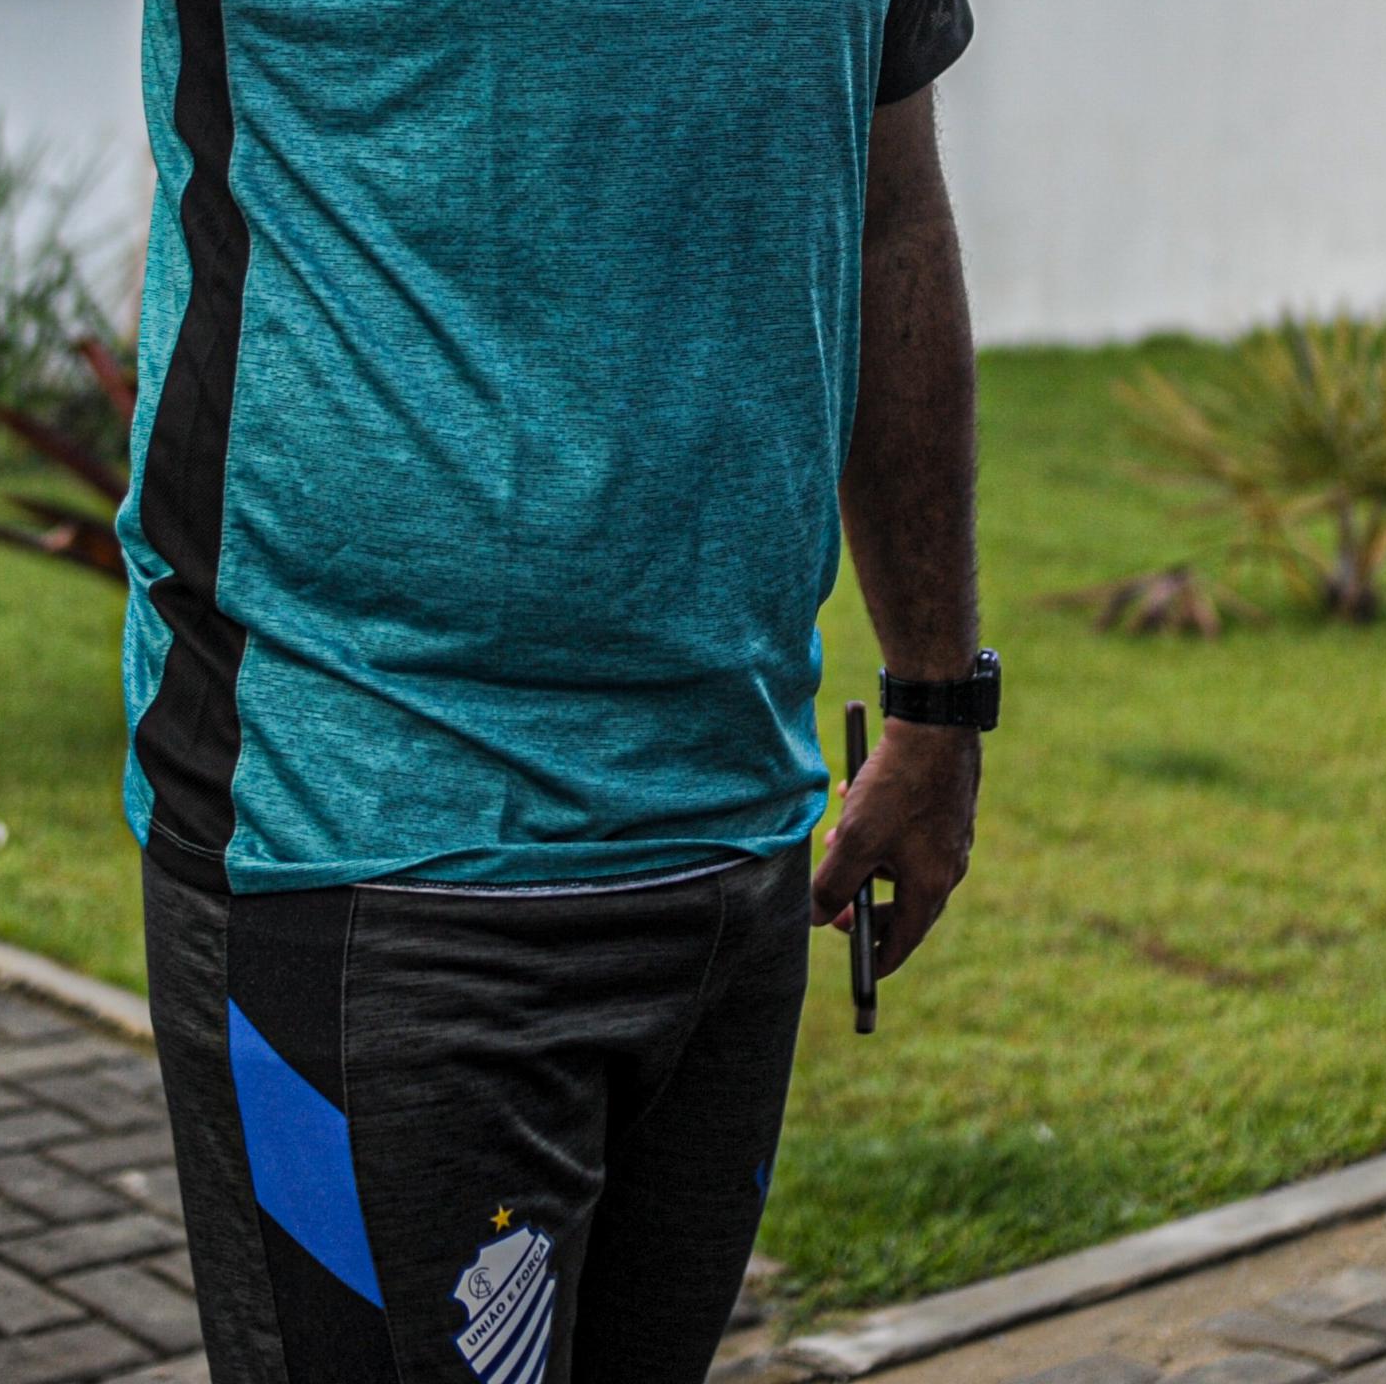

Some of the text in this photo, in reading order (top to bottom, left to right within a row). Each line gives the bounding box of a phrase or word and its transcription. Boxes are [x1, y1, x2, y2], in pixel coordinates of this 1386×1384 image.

[466, 1242, 546, 1346] UNIÃO E FORÇA
